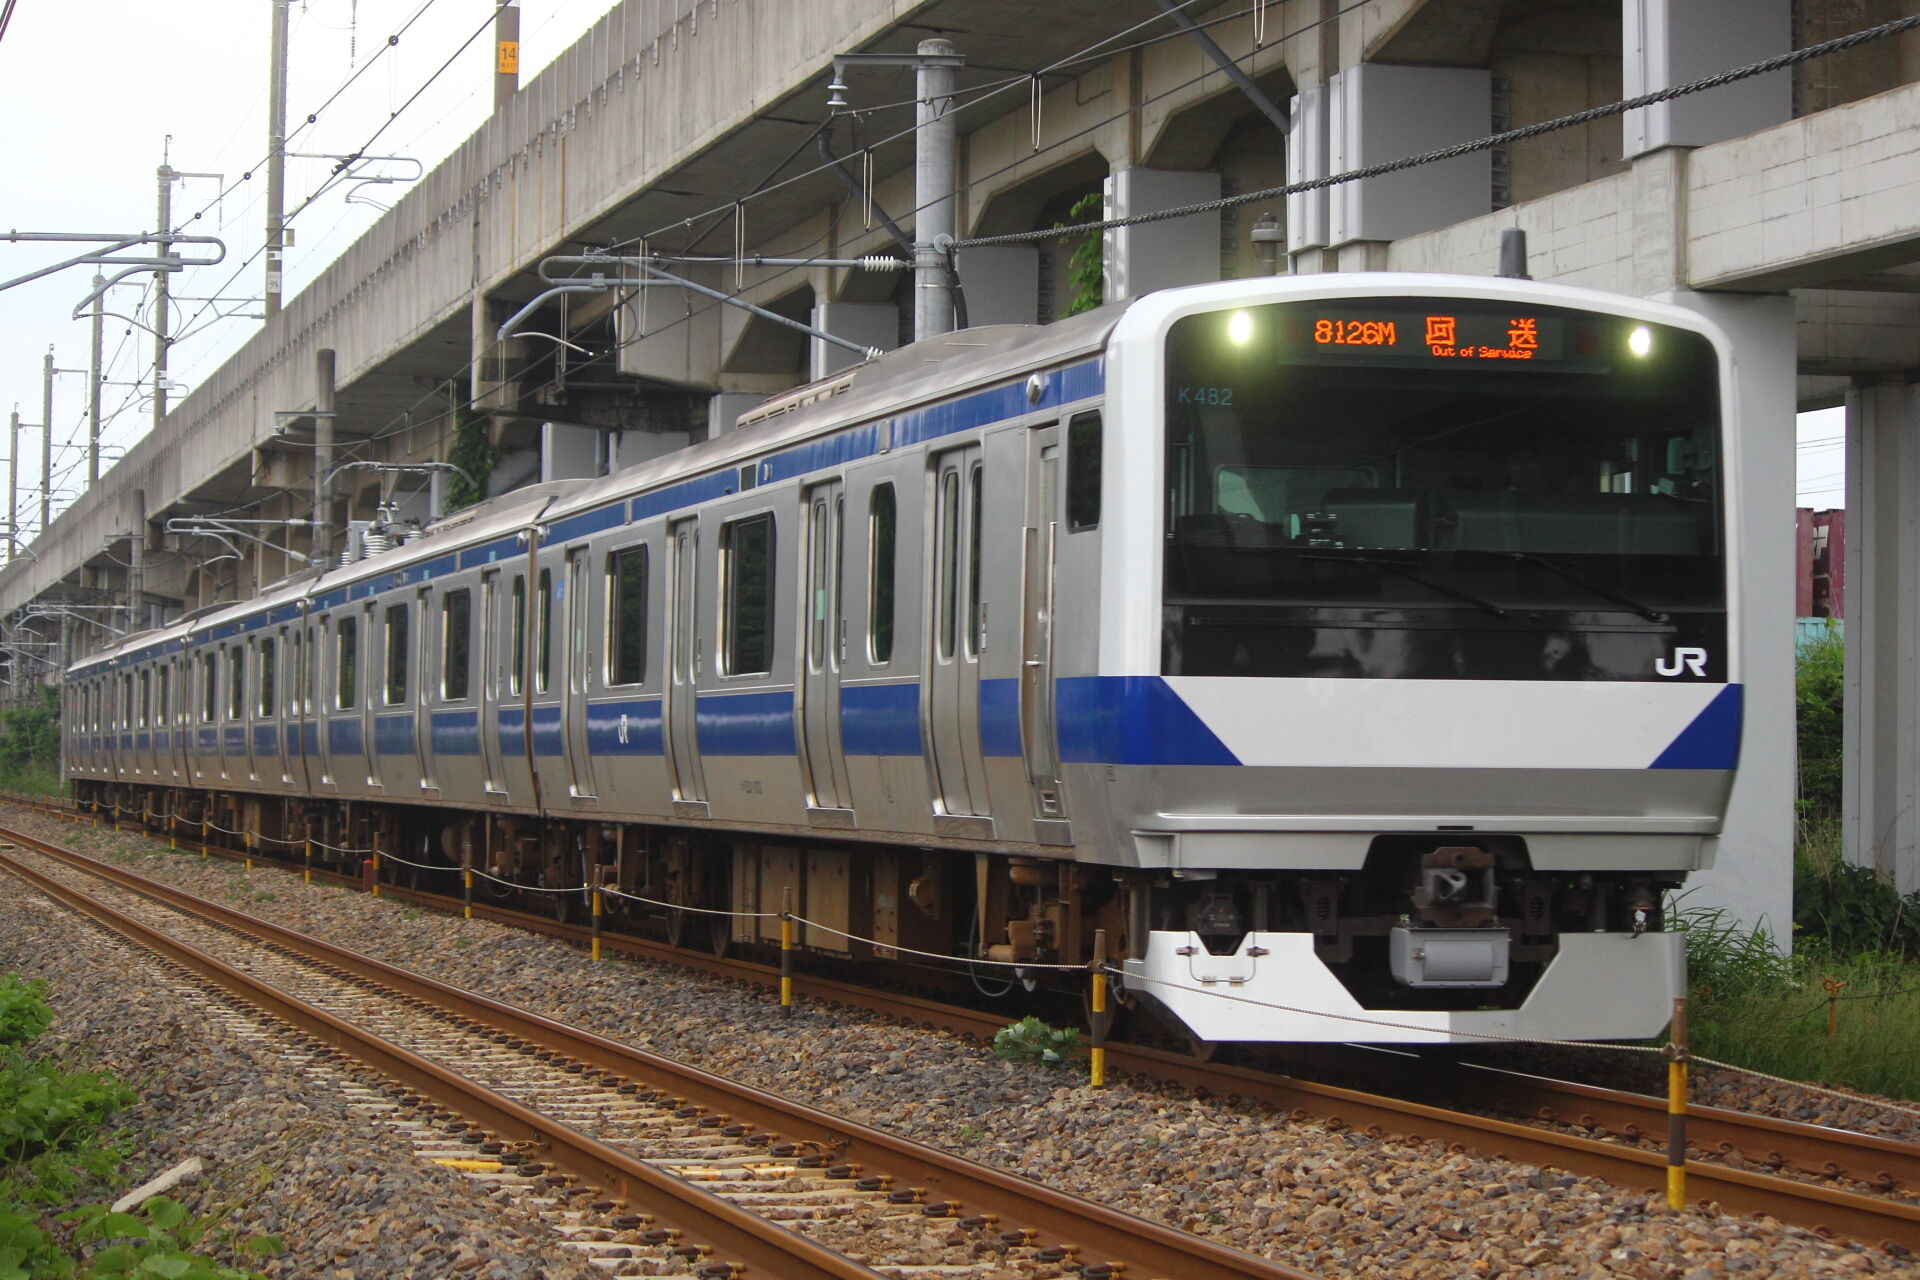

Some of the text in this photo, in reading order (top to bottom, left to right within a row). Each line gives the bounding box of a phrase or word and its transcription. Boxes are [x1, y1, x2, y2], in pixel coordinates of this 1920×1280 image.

[501, 47, 517, 61] 14
[1314, 319, 1396, 345] 8126M
[1431, 345, 1455, 357] Out
[1460, 346, 1475, 357] of
[1178, 387, 1233, 406] K482
[1655, 647, 1707, 677] JR
[617, 714, 629, 744] JR
